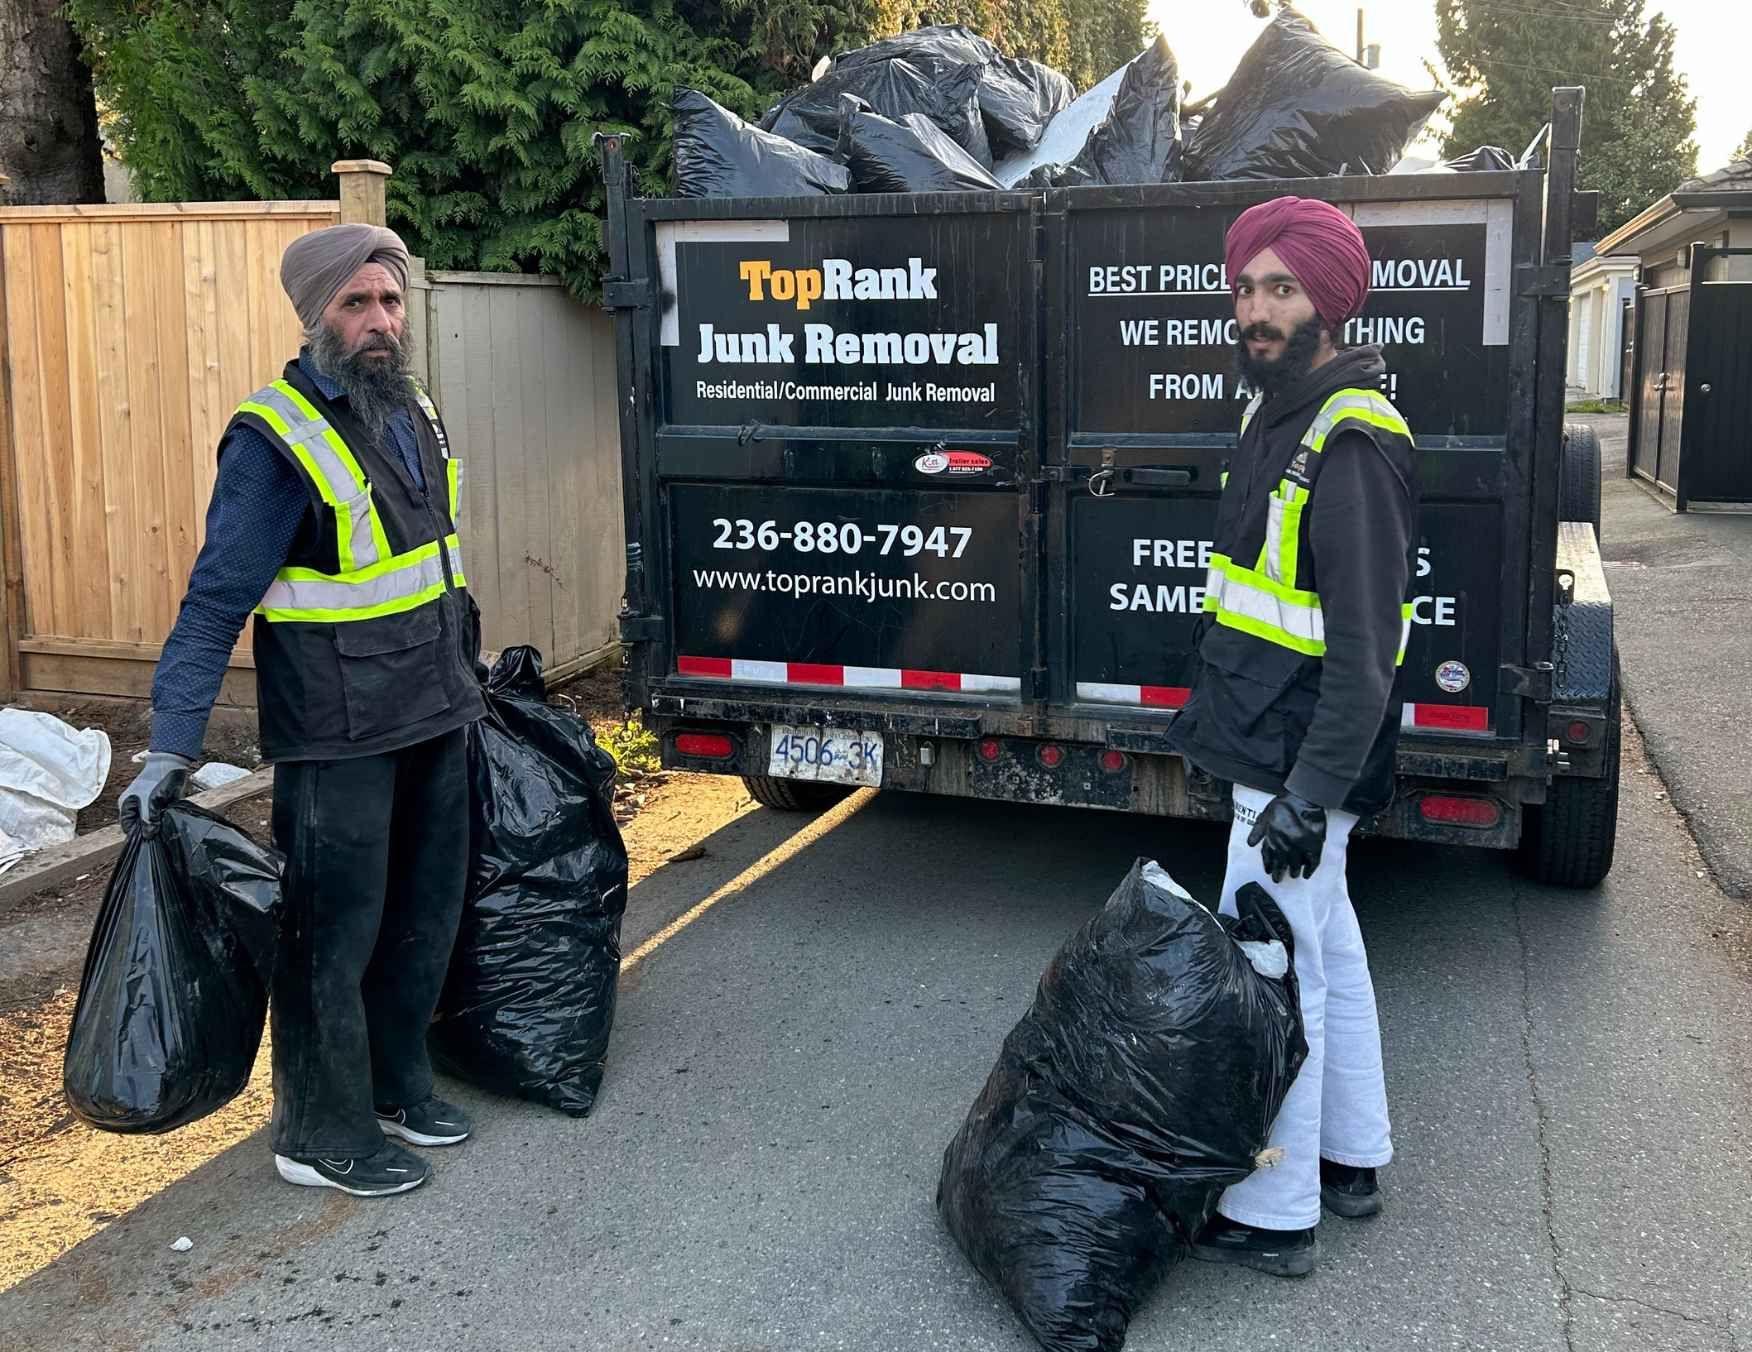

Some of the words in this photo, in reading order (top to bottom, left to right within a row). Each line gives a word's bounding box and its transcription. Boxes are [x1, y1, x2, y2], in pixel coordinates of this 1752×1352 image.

[739, 257, 937, 310] TopRank
[1089, 265, 1152, 292] BEST
[1372, 259, 1470, 287] MOVAL
[697, 323, 795, 365] Junk
[804, 323, 999, 365] Removal
[1120, 320, 1159, 346] WE
[1167, 319, 1240, 345] REMO
[1344, 316, 1425, 344] THING
[697, 380, 877, 401] Residential/Commercial
[886, 382, 922, 401] Junk
[926, 382, 996, 402] Removal
[1149, 373, 1223, 400] FROM
[712, 518, 973, 558] 236-880-7947
[1133, 539, 1213, 568] FREE
[693, 568, 996, 603] www.toprankjunk.com
[1109, 583, 1206, 614] SAME
